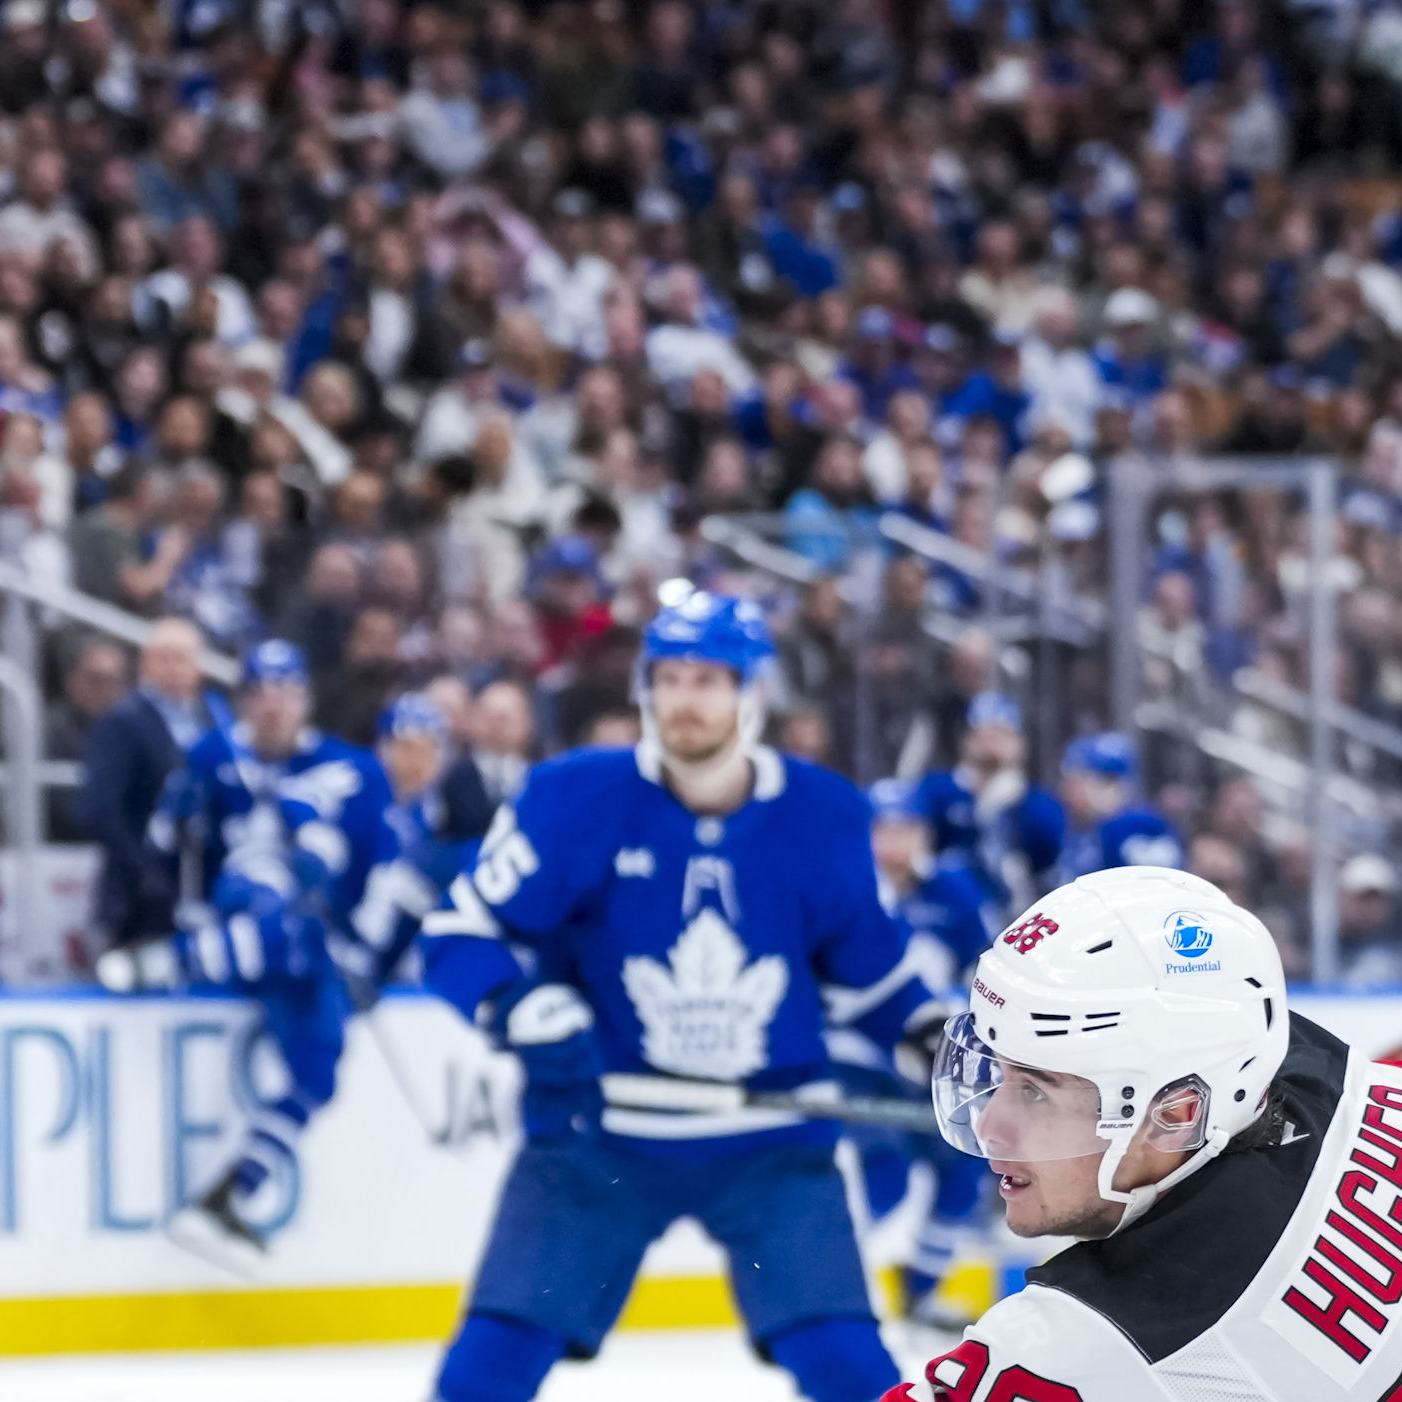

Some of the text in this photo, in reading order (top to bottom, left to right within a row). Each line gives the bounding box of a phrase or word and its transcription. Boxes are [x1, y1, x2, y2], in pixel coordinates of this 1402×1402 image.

[474, 803, 540, 905] 5
[1003, 912, 1059, 955] 86
[1165, 960, 1221, 974] Prudential
